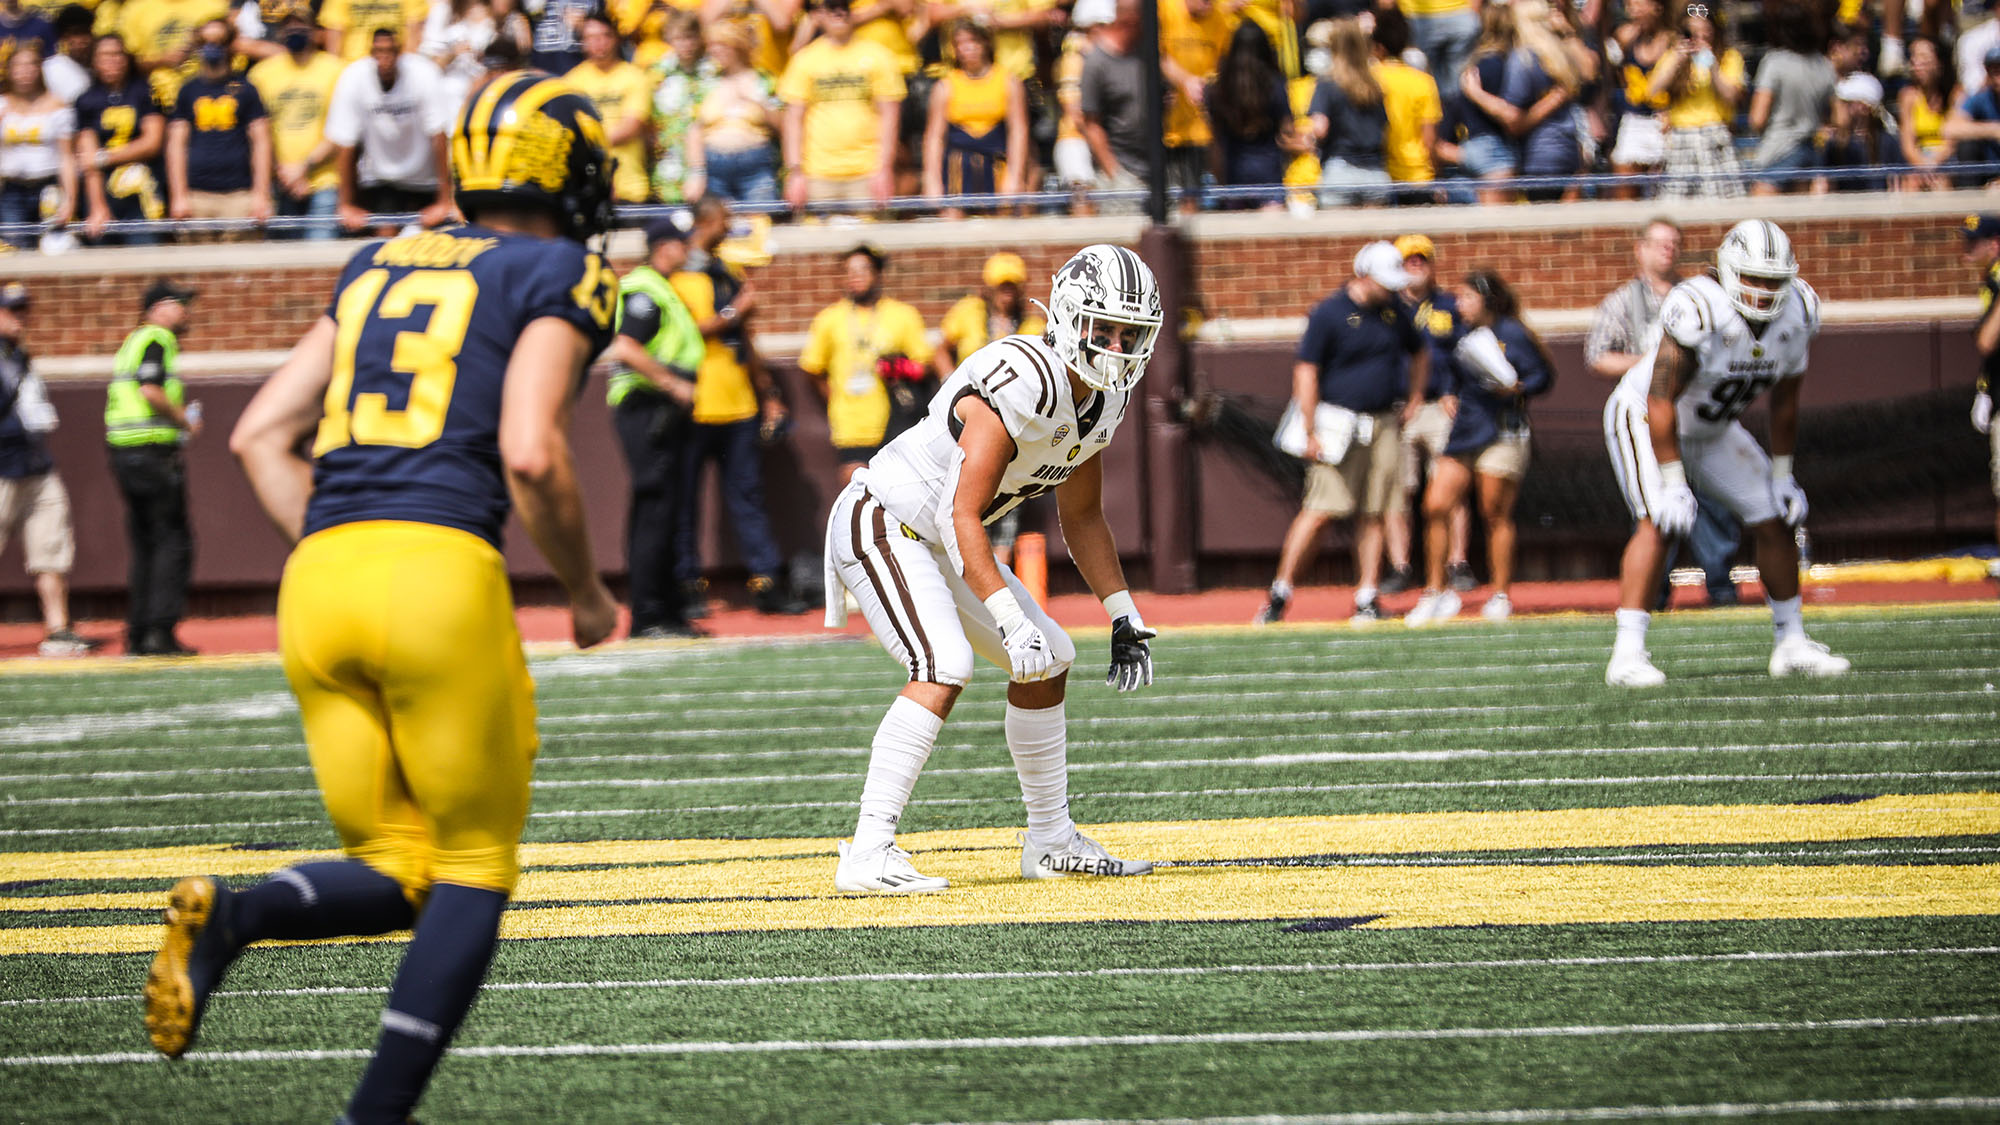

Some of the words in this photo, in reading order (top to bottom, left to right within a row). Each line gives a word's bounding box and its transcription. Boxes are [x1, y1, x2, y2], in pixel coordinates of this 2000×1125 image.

[1122, 304, 1141, 312] FOUR
[312, 268, 480, 459] 13
[982, 359, 1019, 394] 17
